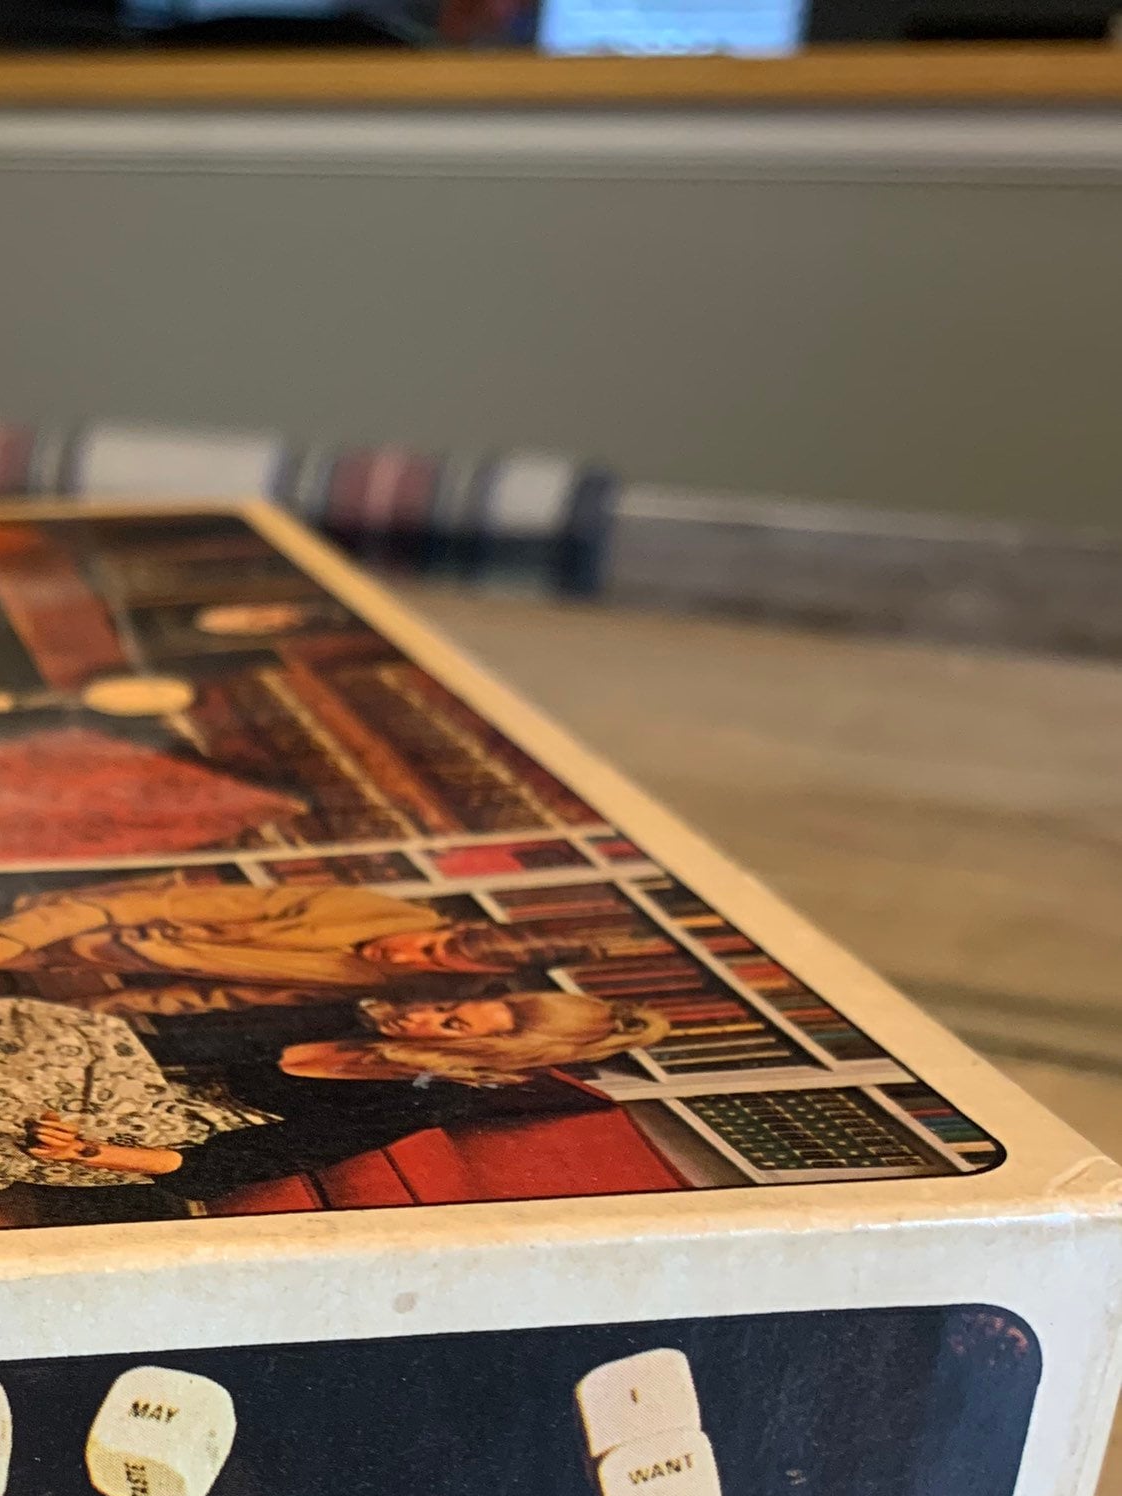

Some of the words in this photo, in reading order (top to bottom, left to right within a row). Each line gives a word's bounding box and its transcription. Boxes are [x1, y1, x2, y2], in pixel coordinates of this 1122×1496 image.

[629, 1385, 641, 1404] I
[129, 1400, 180, 1423] MAY
[628, 1453, 695, 1486] WANT
